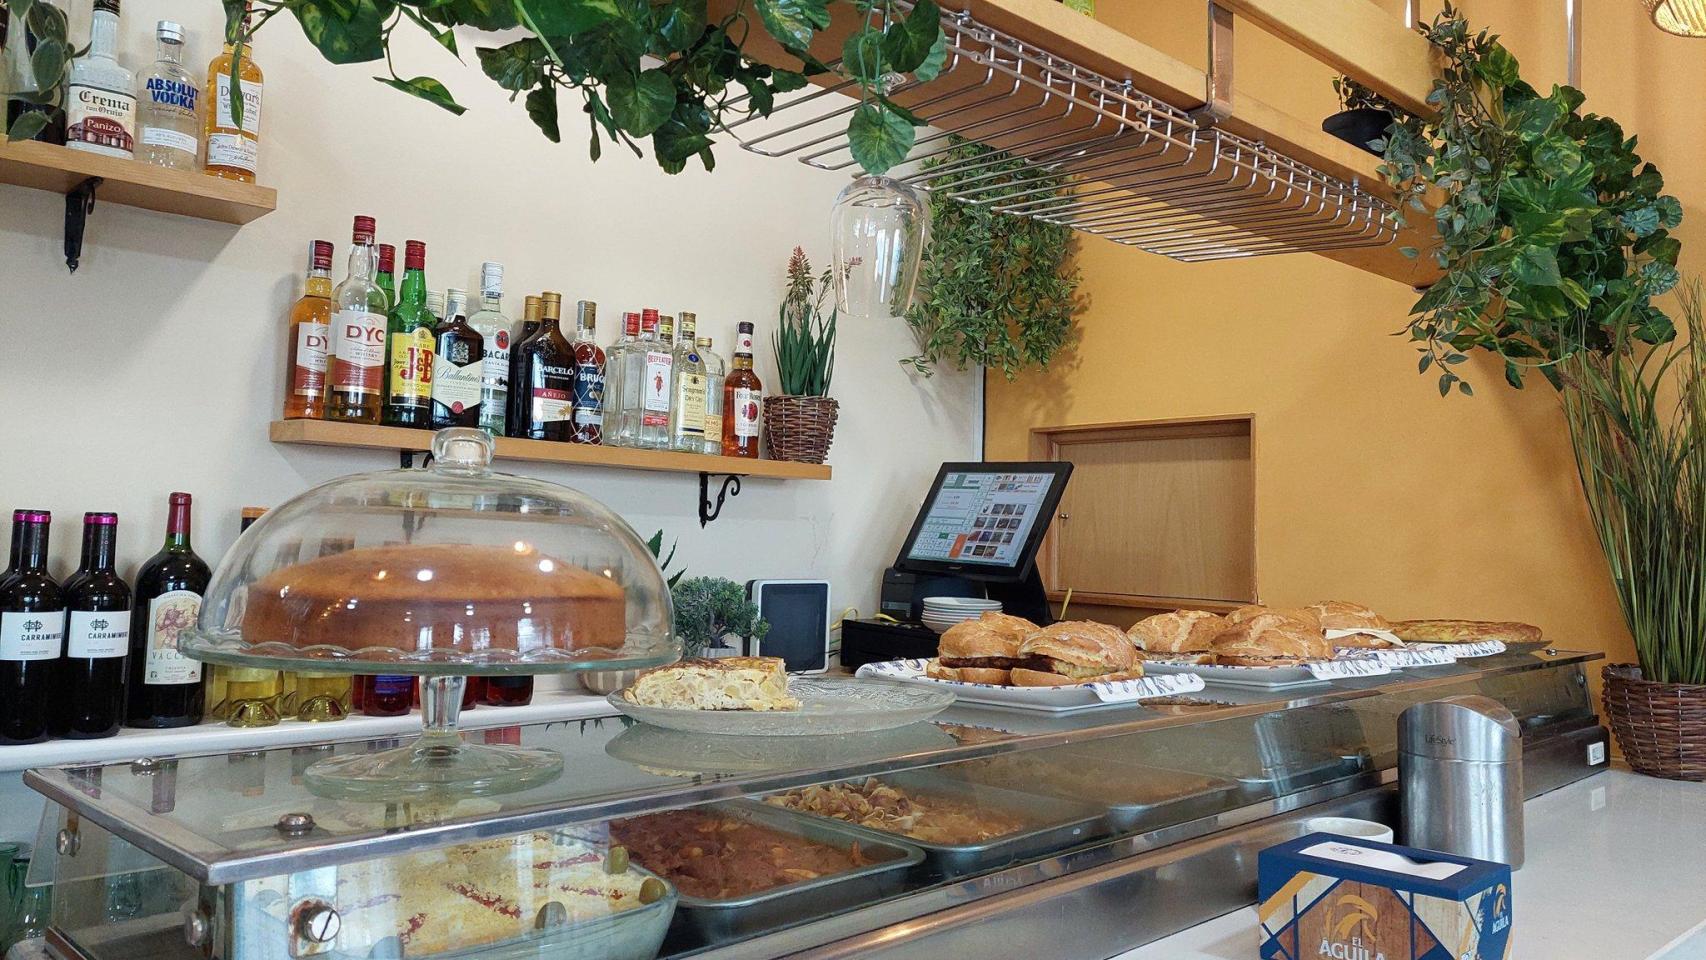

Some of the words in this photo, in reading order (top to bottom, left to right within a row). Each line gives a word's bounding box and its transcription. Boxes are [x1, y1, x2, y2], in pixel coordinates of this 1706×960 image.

[146, 78, 200, 100] ABSOLUT
[220, 86, 260, 105] Dar's
[79, 90, 130, 111] Crema
[152, 91, 195, 110] VODKA
[87, 119, 121, 132] Panizo
[346, 324, 385, 343] DYC
[152, 651, 186, 660] VACC
[1352, 936, 1362, 946] EL
